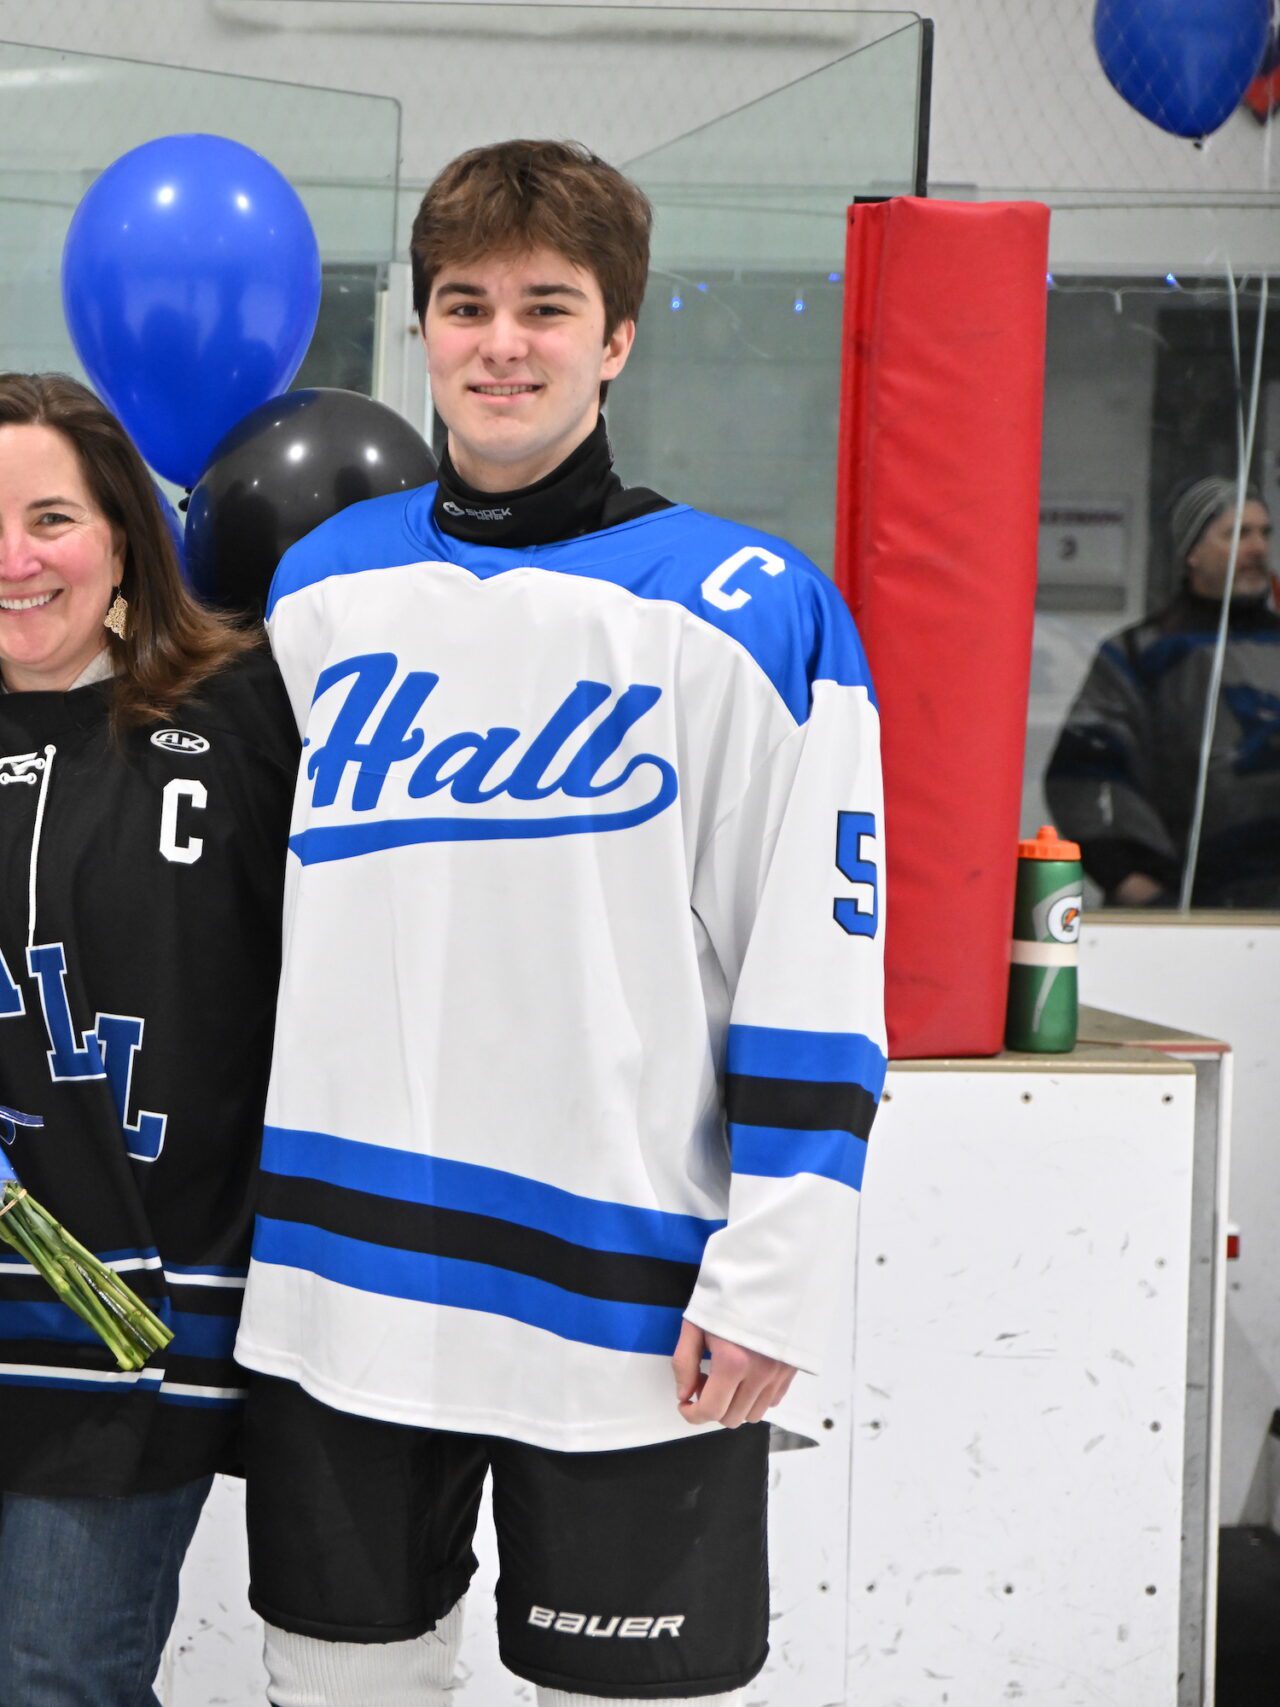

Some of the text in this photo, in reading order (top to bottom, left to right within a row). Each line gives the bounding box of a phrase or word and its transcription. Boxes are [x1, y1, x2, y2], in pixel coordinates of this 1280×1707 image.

[465, 507, 513, 517] SHOCK
[702, 546, 786, 611] C
[304, 652, 675, 812] Hall
[160, 778, 208, 864] C
[833, 810, 879, 940] 5
[527, 1605, 685, 1639] BAUER
